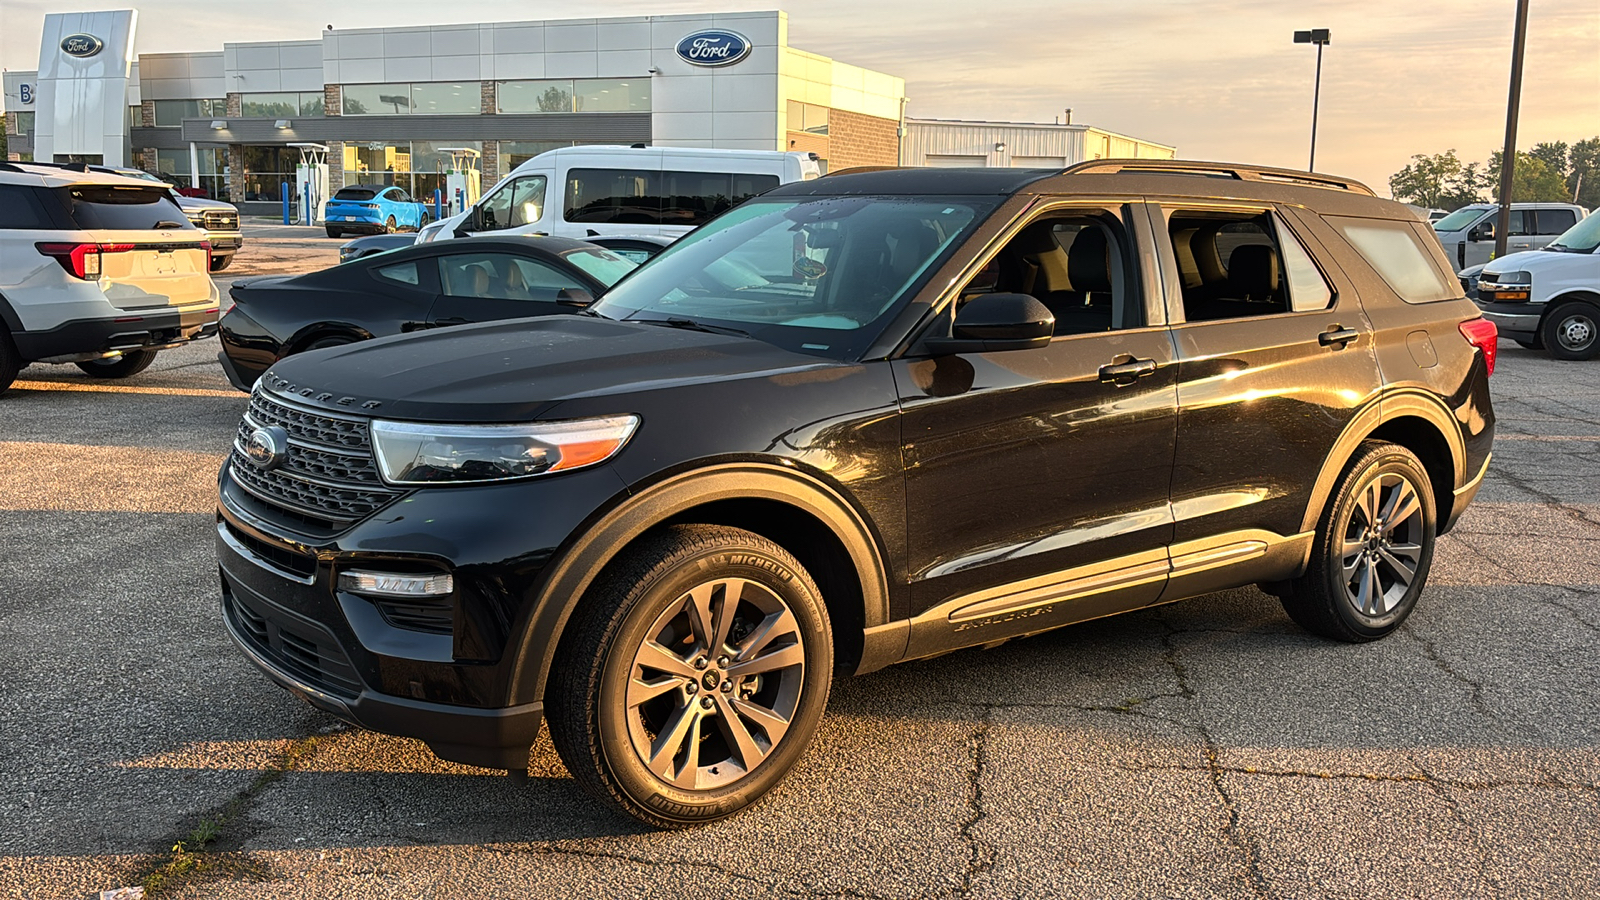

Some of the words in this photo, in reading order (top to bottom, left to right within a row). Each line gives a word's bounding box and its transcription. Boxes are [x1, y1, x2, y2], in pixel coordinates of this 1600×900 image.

[67, 38, 89, 52] Ford
[689, 37, 731, 58] Ford
[264, 371, 383, 409] EXPLORER
[729, 555, 792, 581] MICHELIN
[652, 795, 718, 817] MICHELIN
